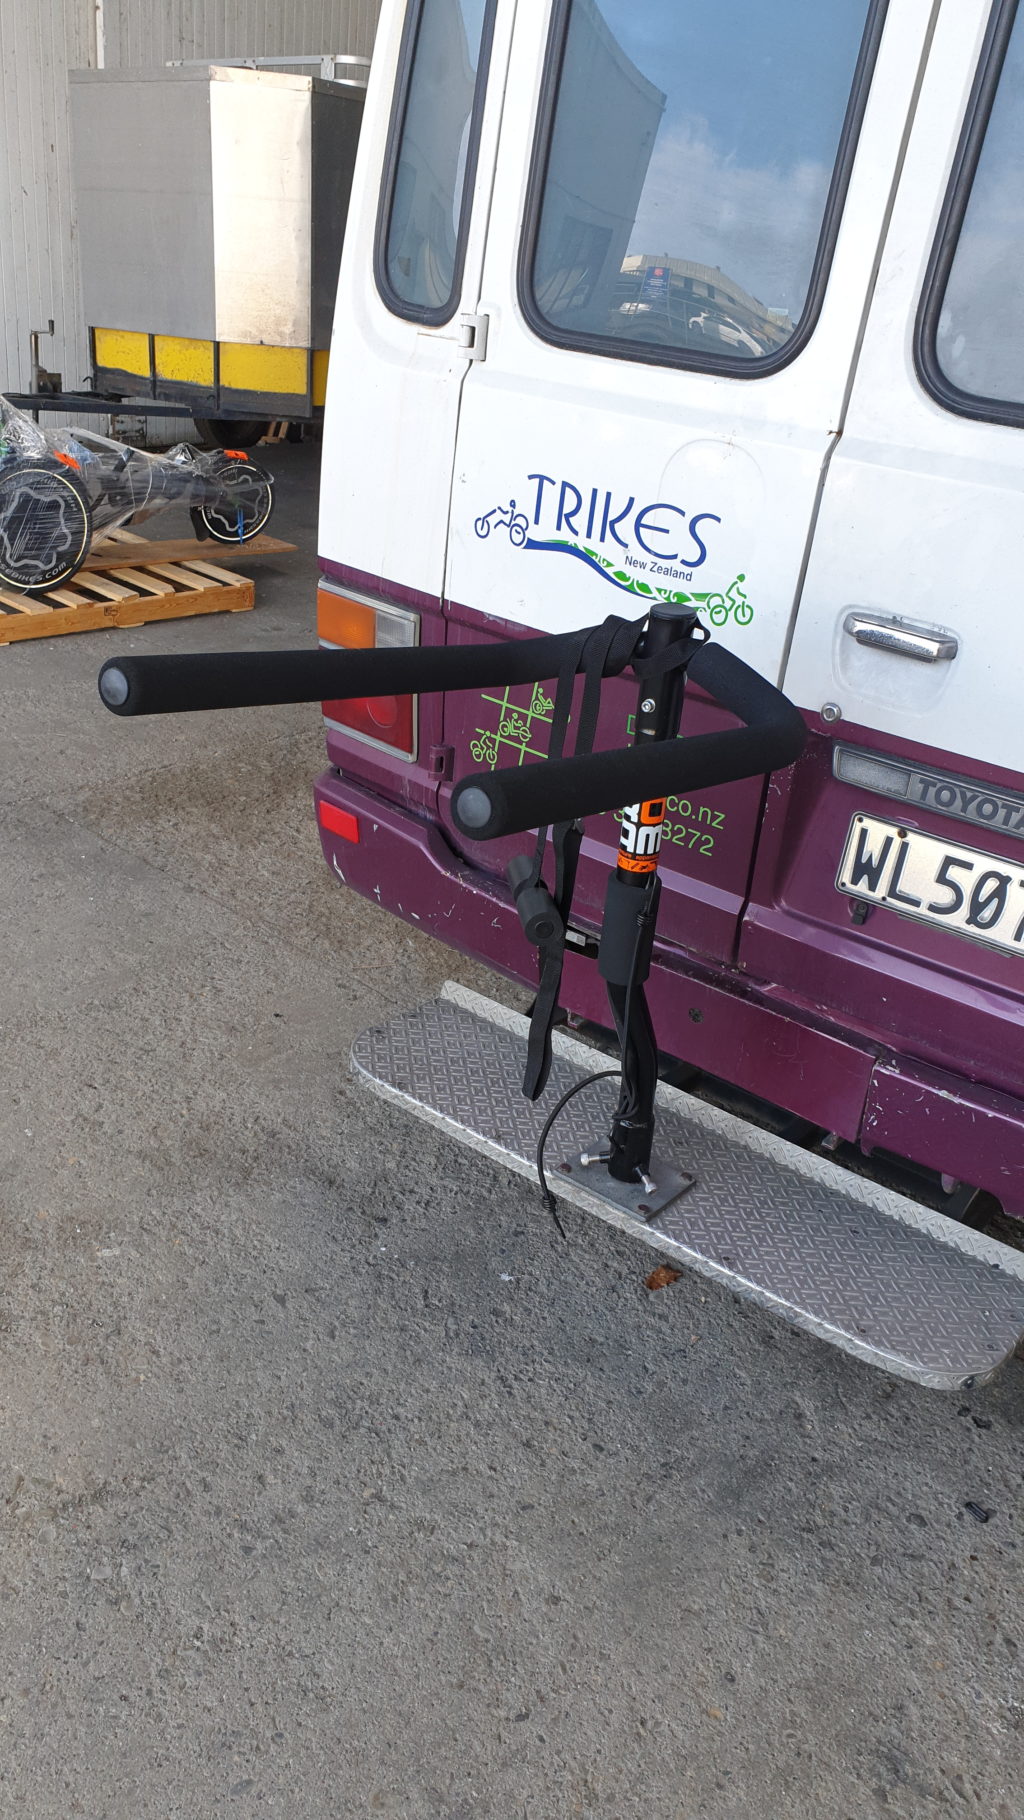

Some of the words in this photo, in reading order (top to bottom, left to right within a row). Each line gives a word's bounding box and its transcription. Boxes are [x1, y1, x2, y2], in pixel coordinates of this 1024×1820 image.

[527, 473, 722, 568] TRIKES
[624, 554, 647, 570] New
[649, 561, 693, 582] Zealand
